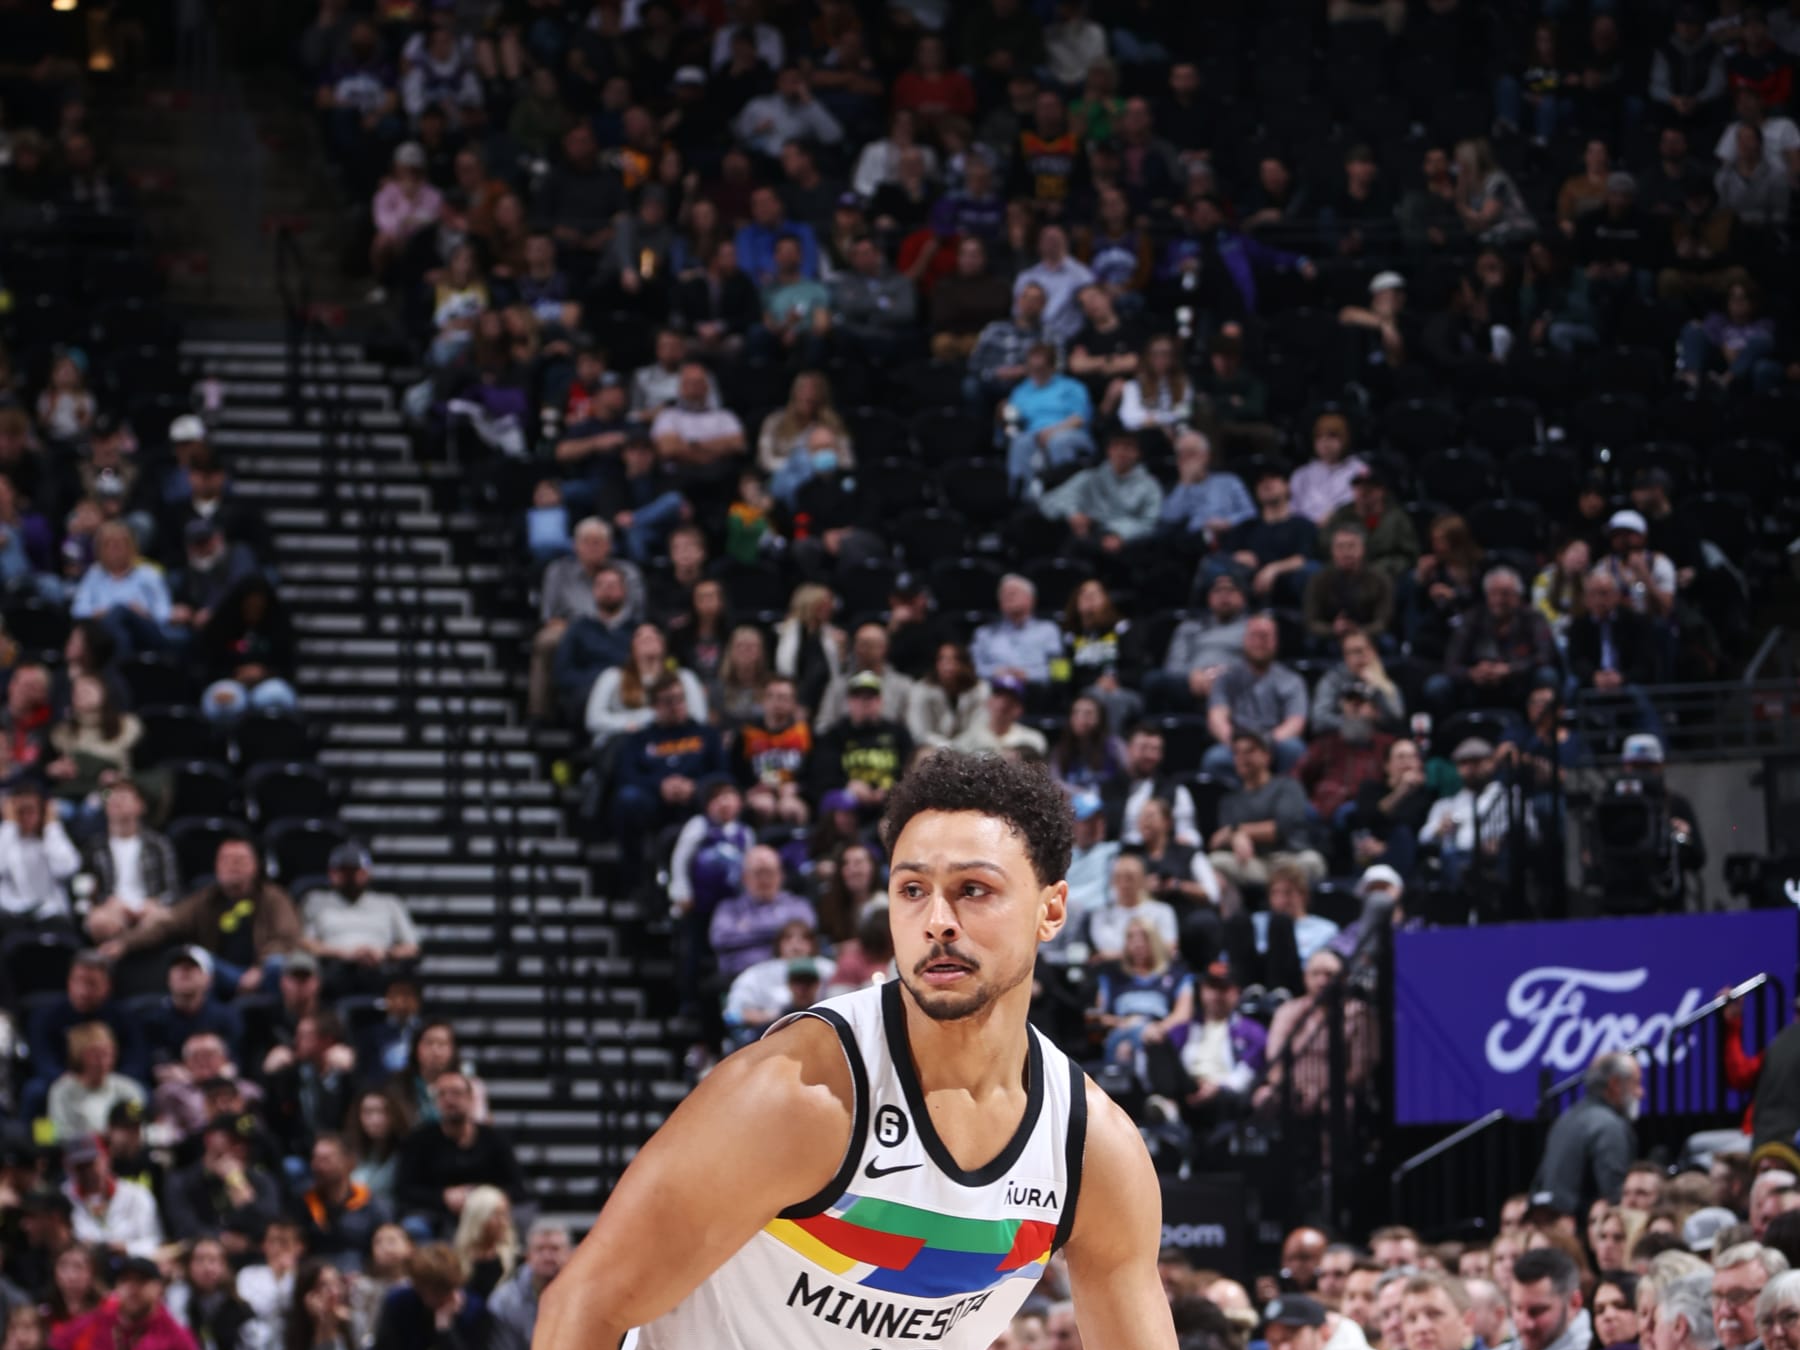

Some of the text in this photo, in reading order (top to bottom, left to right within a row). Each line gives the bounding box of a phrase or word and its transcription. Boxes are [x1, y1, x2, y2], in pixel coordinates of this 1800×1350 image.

[1485, 966, 1702, 1073] Ford
[879, 1110, 900, 1143] 6
[1161, 1223, 1226, 1249] oom
[786, 1271, 994, 1341] MINNESOTA
